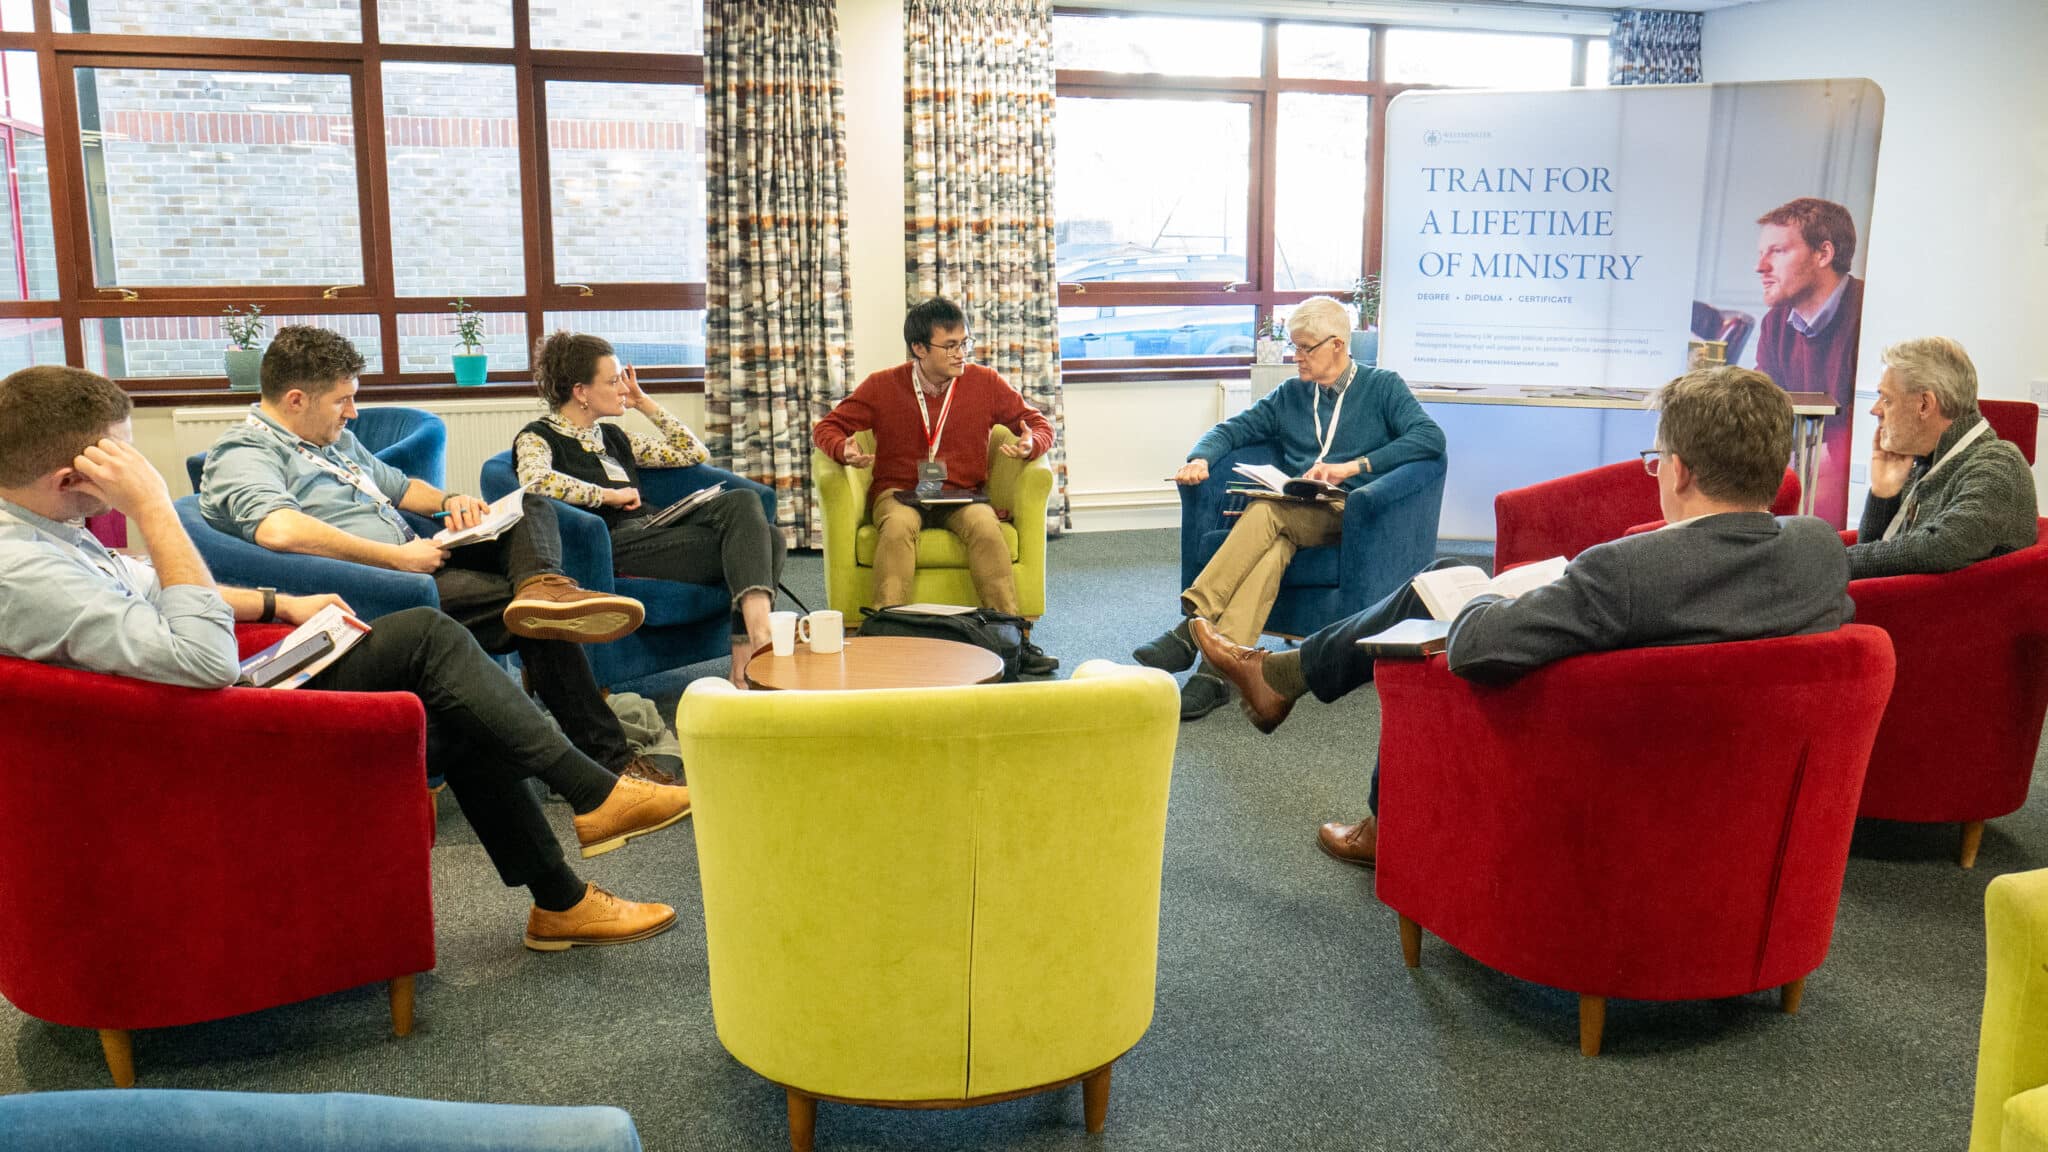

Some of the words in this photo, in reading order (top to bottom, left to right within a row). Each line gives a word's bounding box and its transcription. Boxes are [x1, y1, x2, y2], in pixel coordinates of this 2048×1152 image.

[1421, 167, 1534, 192] TRAIN
[1543, 166, 1613, 193] FOR
[1419, 209, 1442, 235] A
[1450, 210, 1614, 236] LIFETIME
[1418, 251, 1462, 277] OF
[1471, 252, 1643, 280] MINISTRY
[1417, 293, 1450, 301] DEGREE
[1464, 294, 1504, 302] DIPLOMA
[1518, 295, 1573, 304] CERTIFICATE
